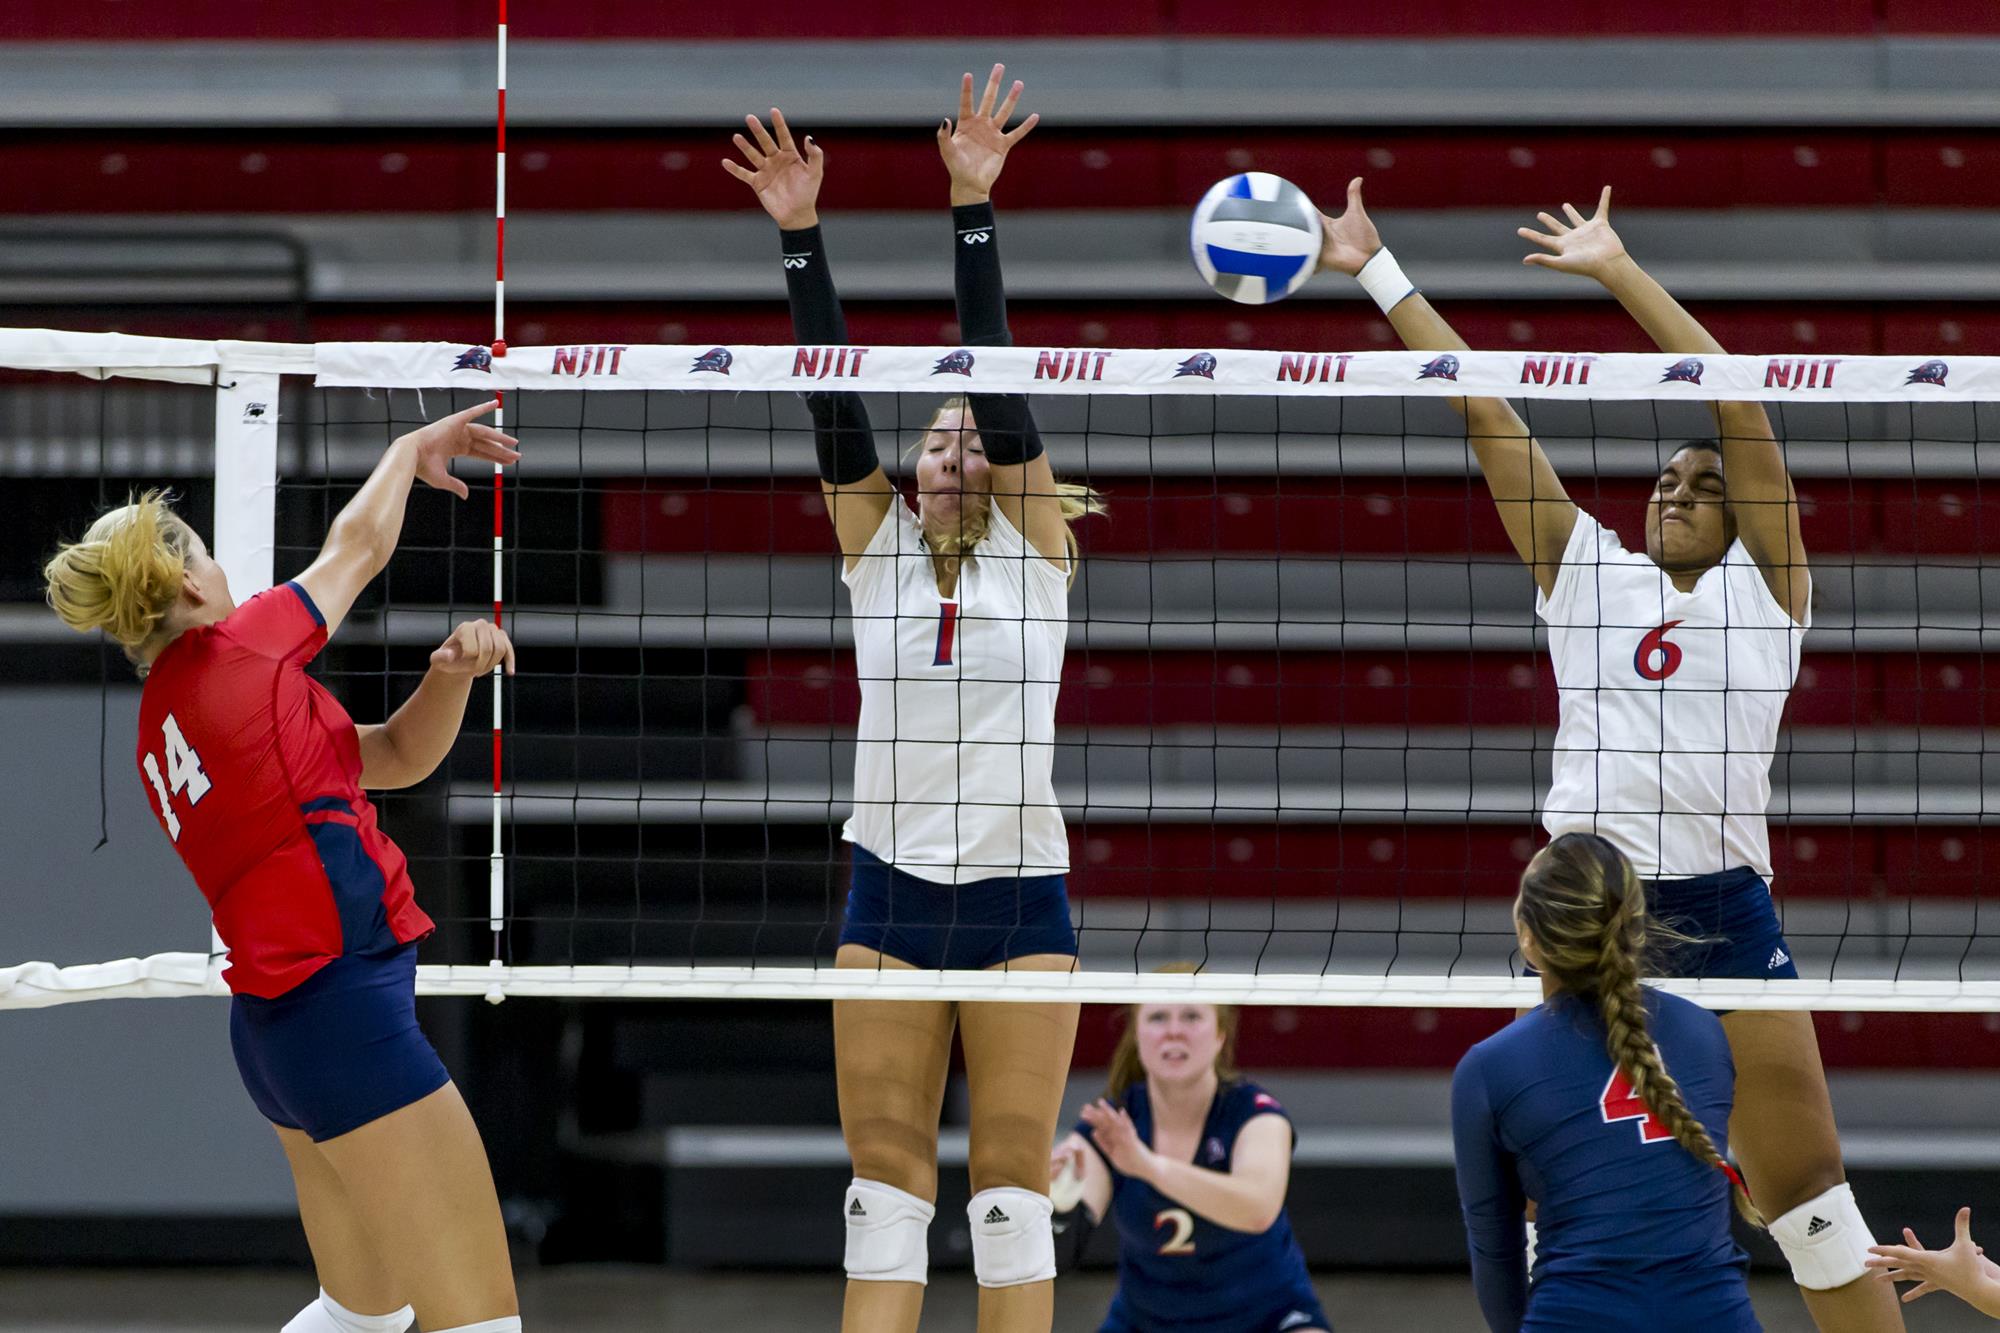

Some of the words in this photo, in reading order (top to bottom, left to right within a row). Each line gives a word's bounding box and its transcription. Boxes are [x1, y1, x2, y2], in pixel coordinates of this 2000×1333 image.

[552, 346, 627, 378] NJIT
[792, 347, 869, 380] NJIT
[1034, 351, 1112, 382] NJIT
[1277, 354, 1354, 385] NJIT
[1520, 355, 1598, 387] NJIT
[1764, 359, 1842, 391] NJIT
[931, 603, 958, 666] 1
[1633, 619, 1686, 681] 6
[142, 711, 213, 843] 14
[1599, 1043, 1680, 1144] 4
[983, 1215, 1010, 1224] adidas
[1154, 1208, 1196, 1256] 2
